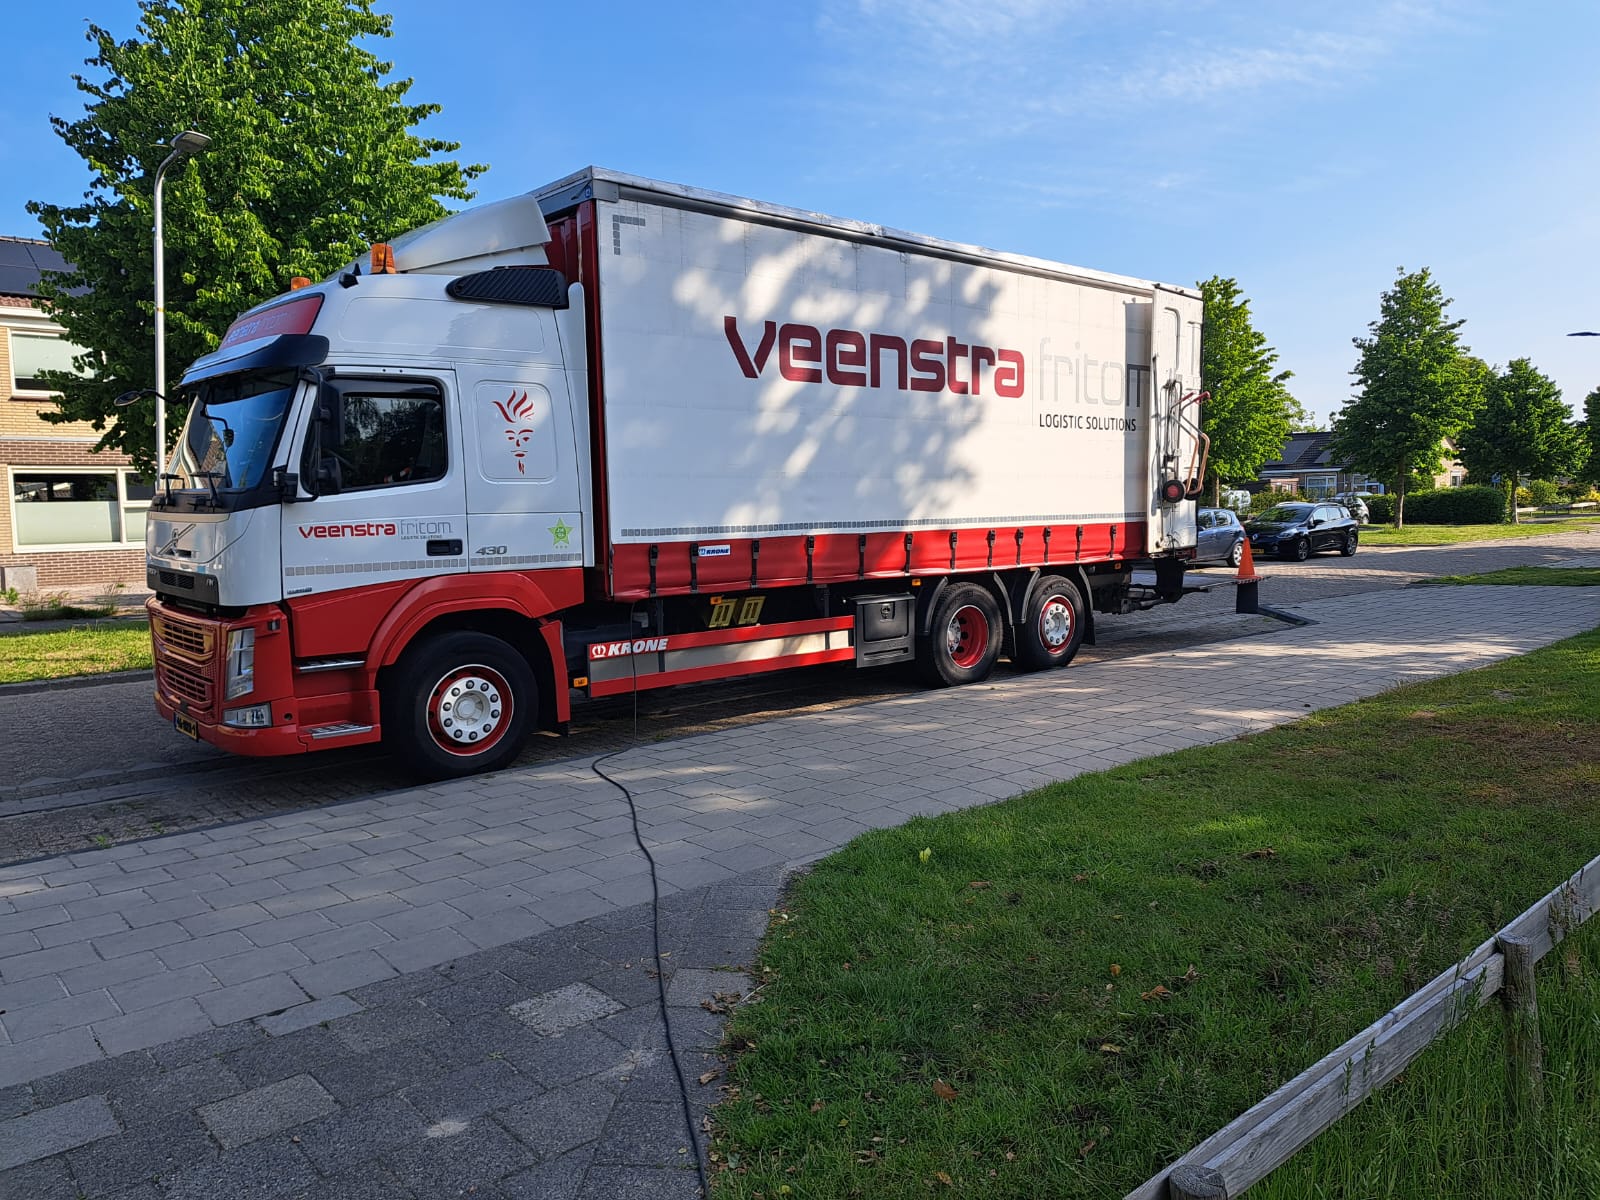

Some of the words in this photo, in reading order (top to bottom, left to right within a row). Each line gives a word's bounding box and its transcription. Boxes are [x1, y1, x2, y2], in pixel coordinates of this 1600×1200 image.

[724, 315, 1025, 399] veenstra
[1039, 413, 1083, 429] LOGISTIC
[1086, 416, 1137, 432] SOLUTIONS
[298, 522, 396, 538] veenstra
[400, 519, 452, 535] fritom
[475, 545, 508, 556] 430
[608, 638, 669, 656] KRONE
